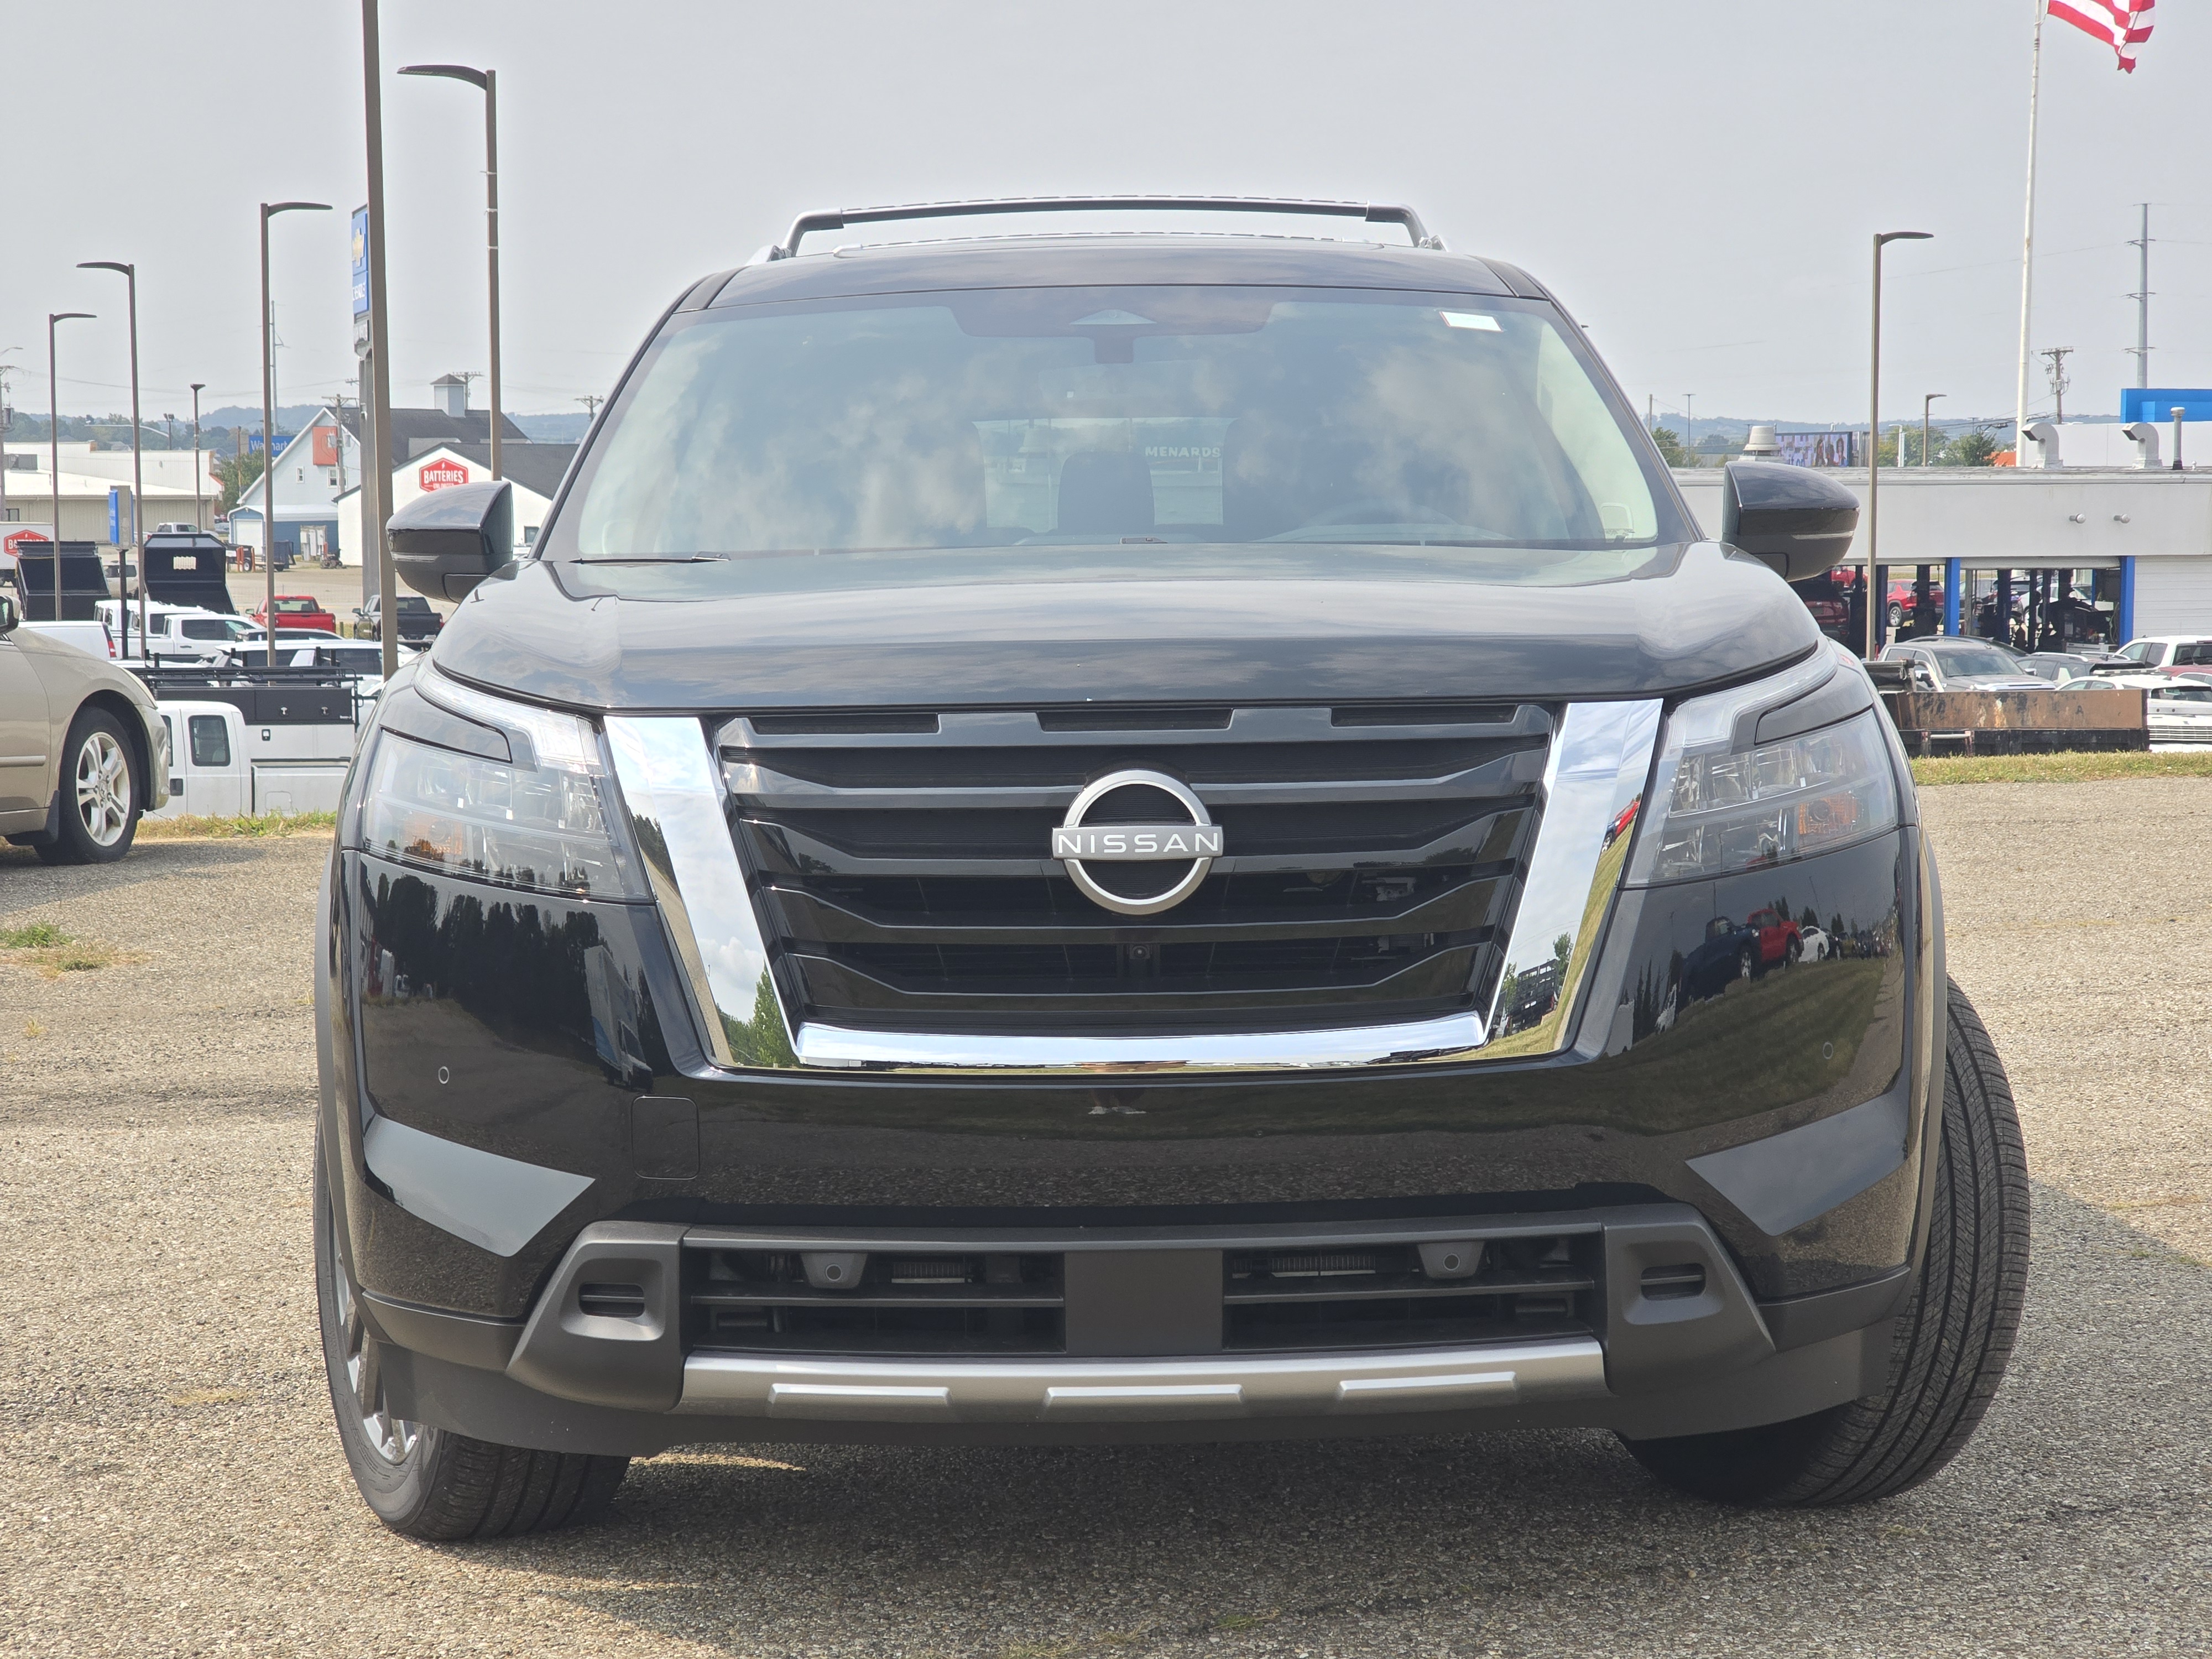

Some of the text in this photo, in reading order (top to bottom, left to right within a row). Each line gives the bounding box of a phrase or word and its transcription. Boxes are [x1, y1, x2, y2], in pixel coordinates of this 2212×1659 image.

[1145, 446, 1221, 457] MENARDS
[424, 470, 463, 484] BATTERIES
[1058, 833, 1218, 853] NISSAN
